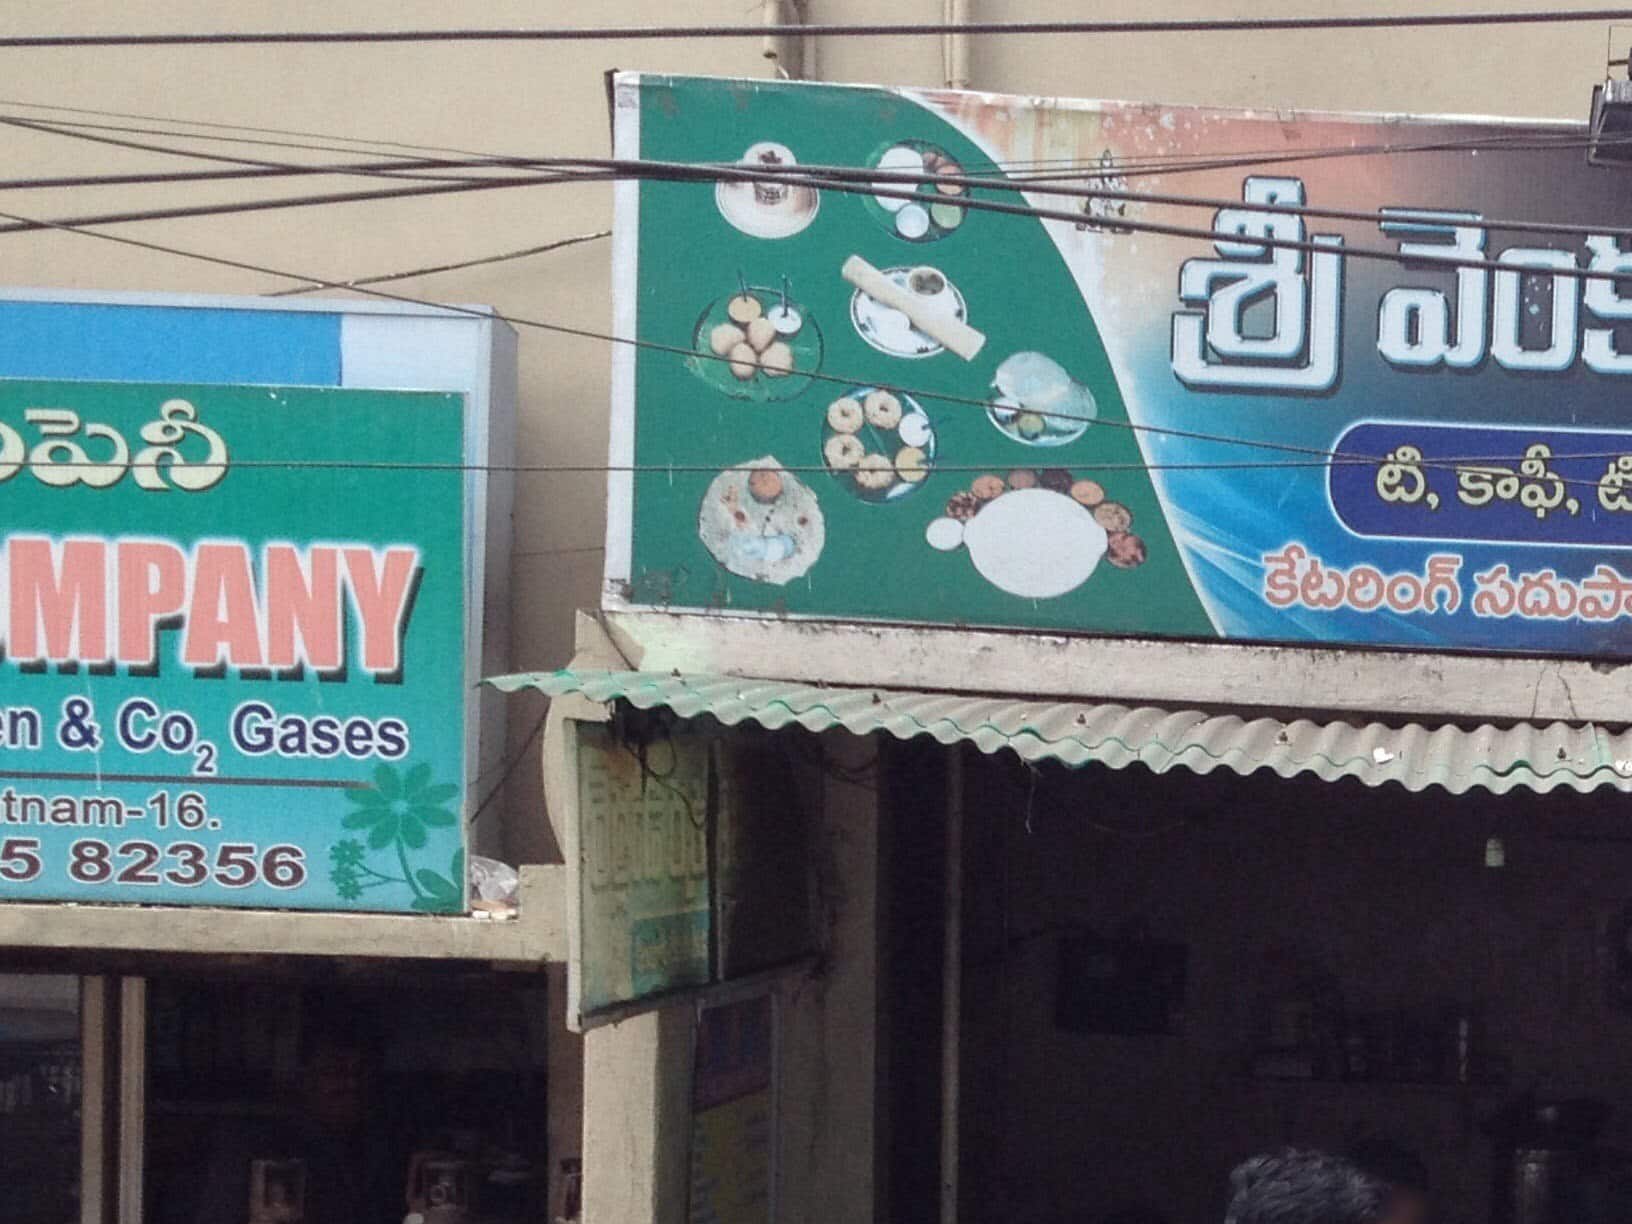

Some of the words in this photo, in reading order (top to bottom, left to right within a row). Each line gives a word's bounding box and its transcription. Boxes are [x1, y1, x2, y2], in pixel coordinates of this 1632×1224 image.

[1170, 174, 1343, 391] శ్రీ
[1262, 544, 1463, 613] కేటరింగ్
[58, 697, 100, 749] &
[232, 702, 409, 758] Gases
[69, 836, 307, 889] 82356
